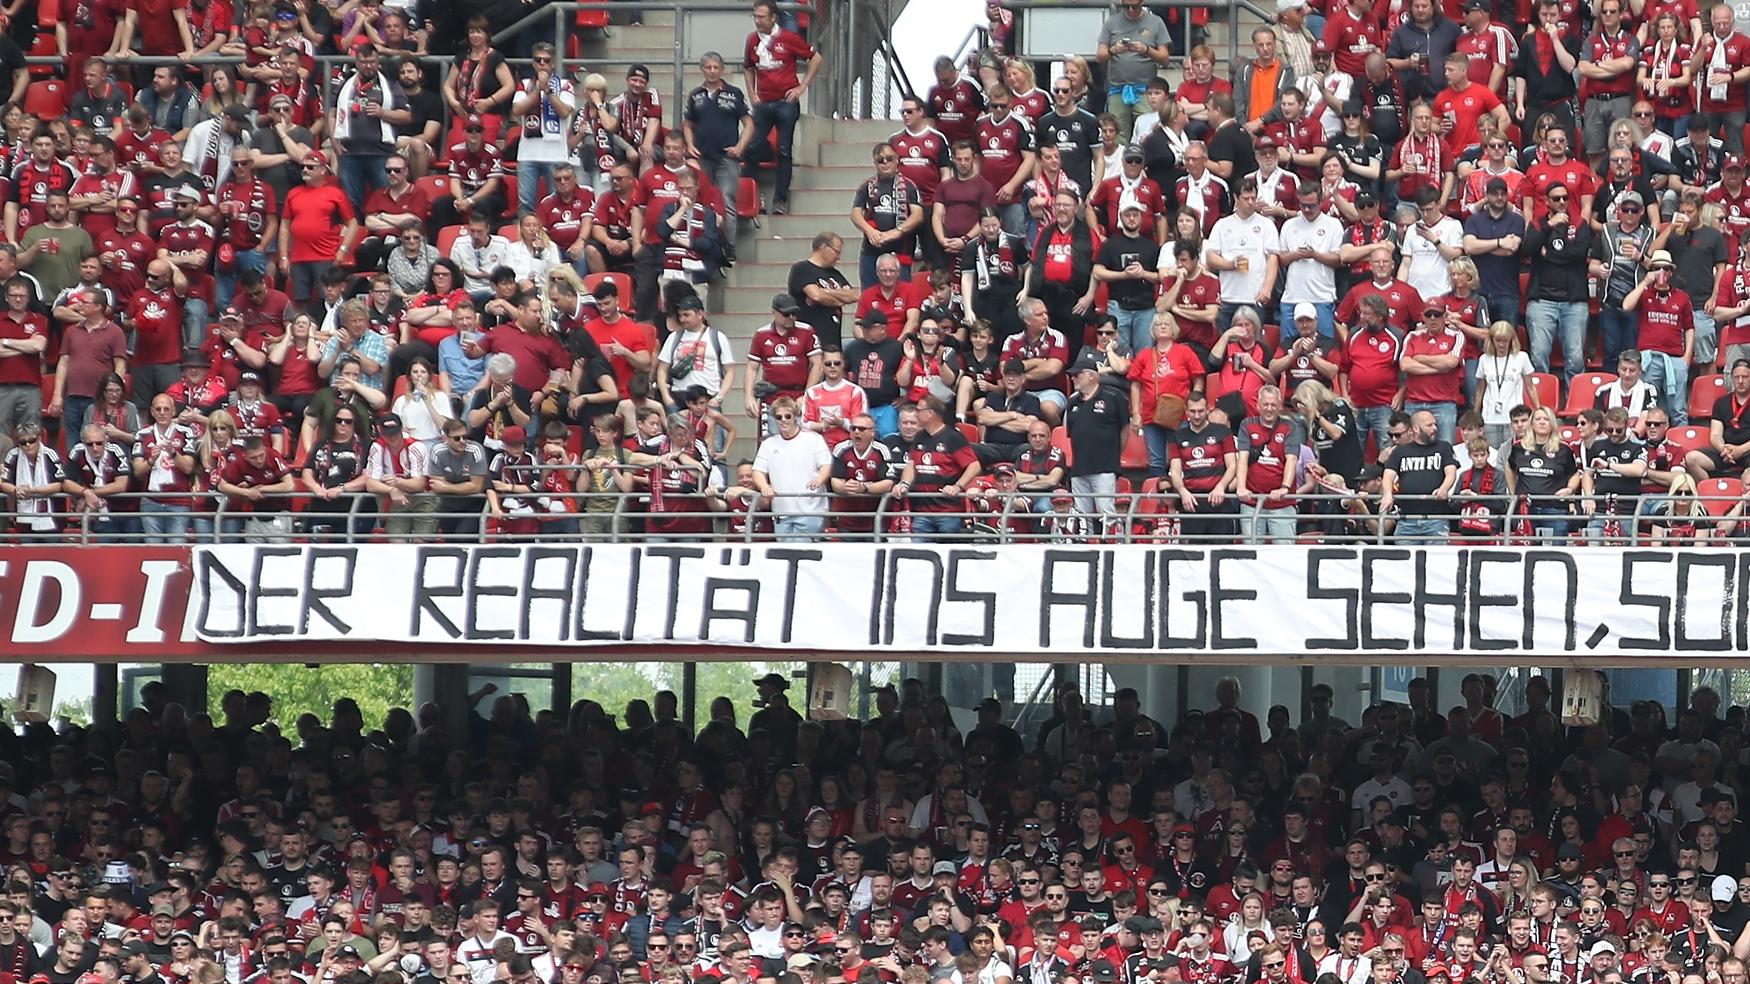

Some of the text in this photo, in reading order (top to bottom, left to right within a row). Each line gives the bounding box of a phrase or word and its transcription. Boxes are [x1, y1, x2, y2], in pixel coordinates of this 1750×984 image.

[1400, 453, 1442, 472] ANTI FÜ
[0, 559, 200, 644] D-I
[195, 547, 359, 640] DER
[412, 547, 822, 645] REALITÄT
[871, 549, 997, 648] INS
[1041, 549, 1258, 651] AUGE
